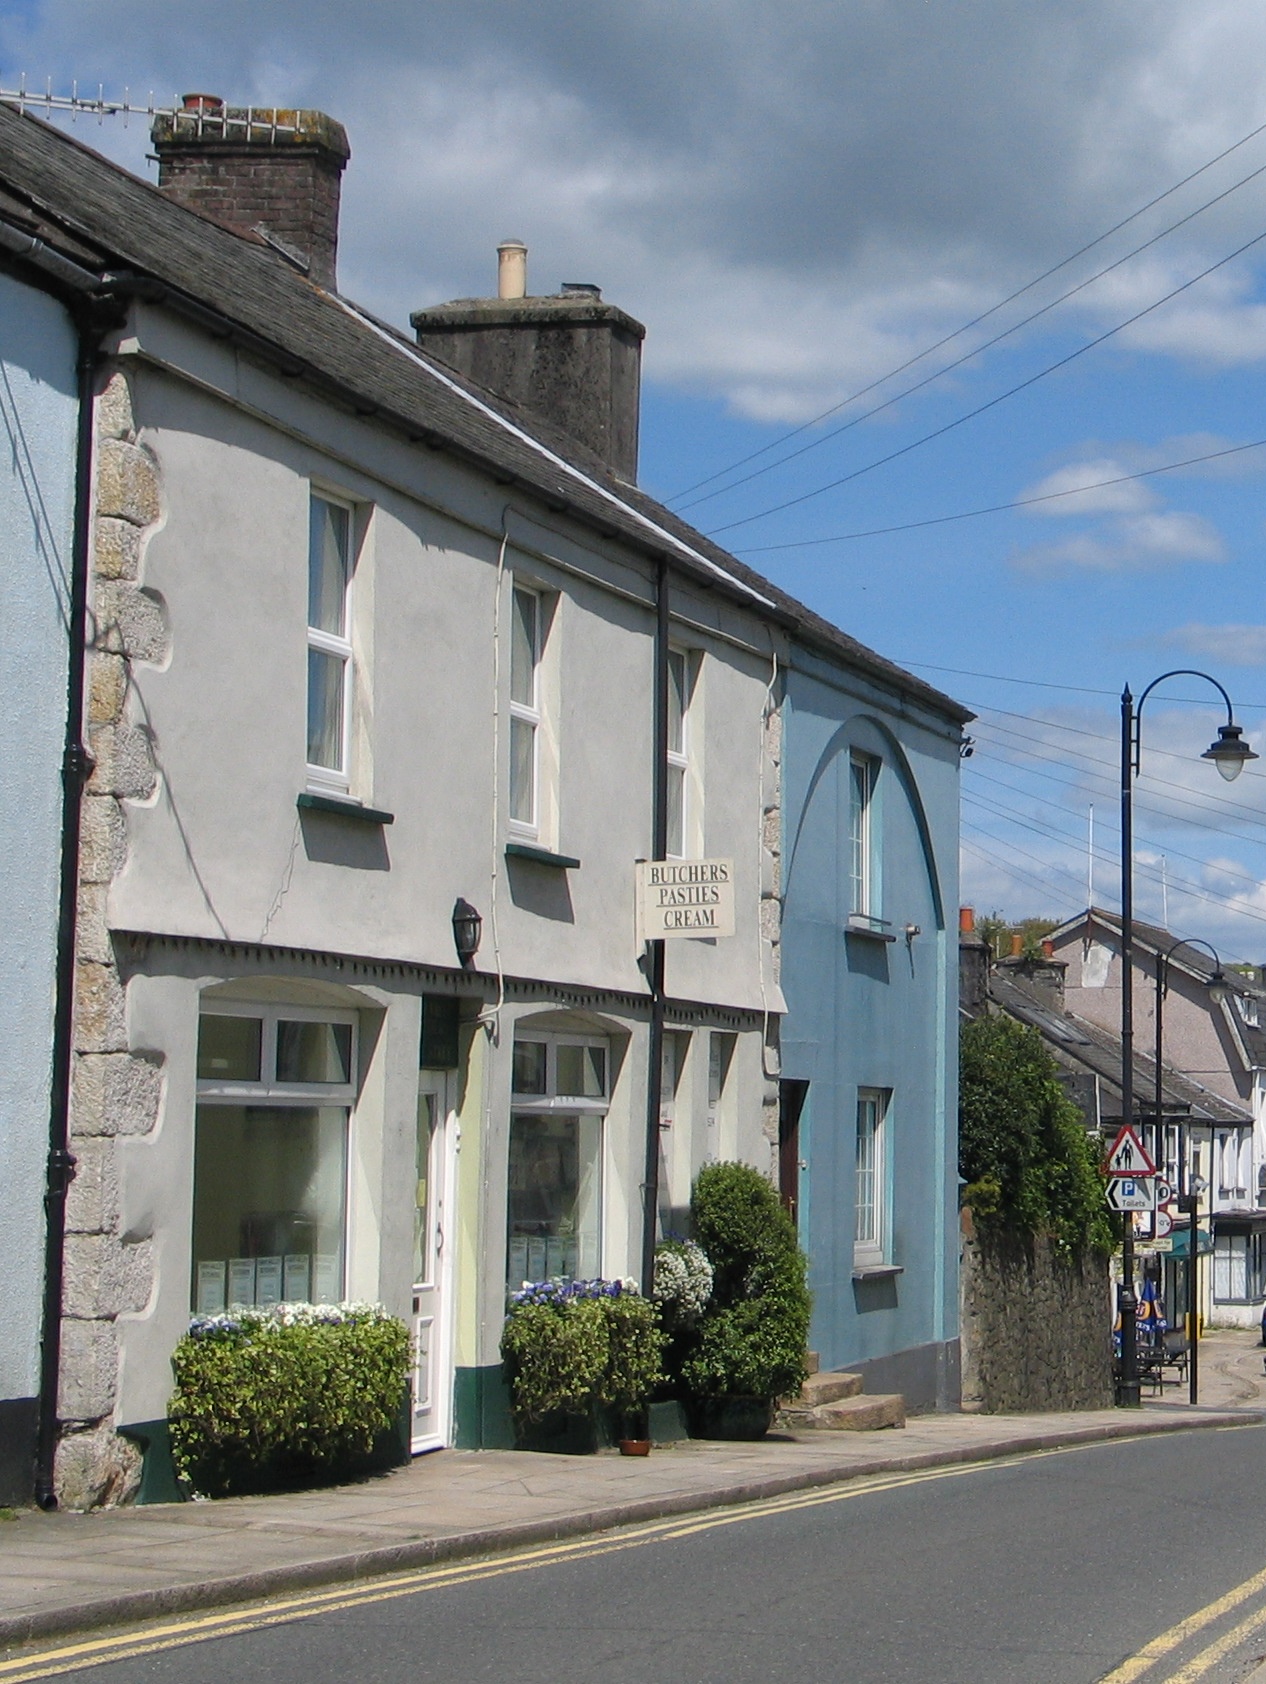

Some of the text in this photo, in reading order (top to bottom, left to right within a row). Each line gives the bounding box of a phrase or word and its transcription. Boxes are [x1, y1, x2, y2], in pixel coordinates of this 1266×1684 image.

[651, 863, 728, 884] BUTCHERS
[660, 885, 719, 905] PASTIES
[664, 909, 715, 928] CREAM
